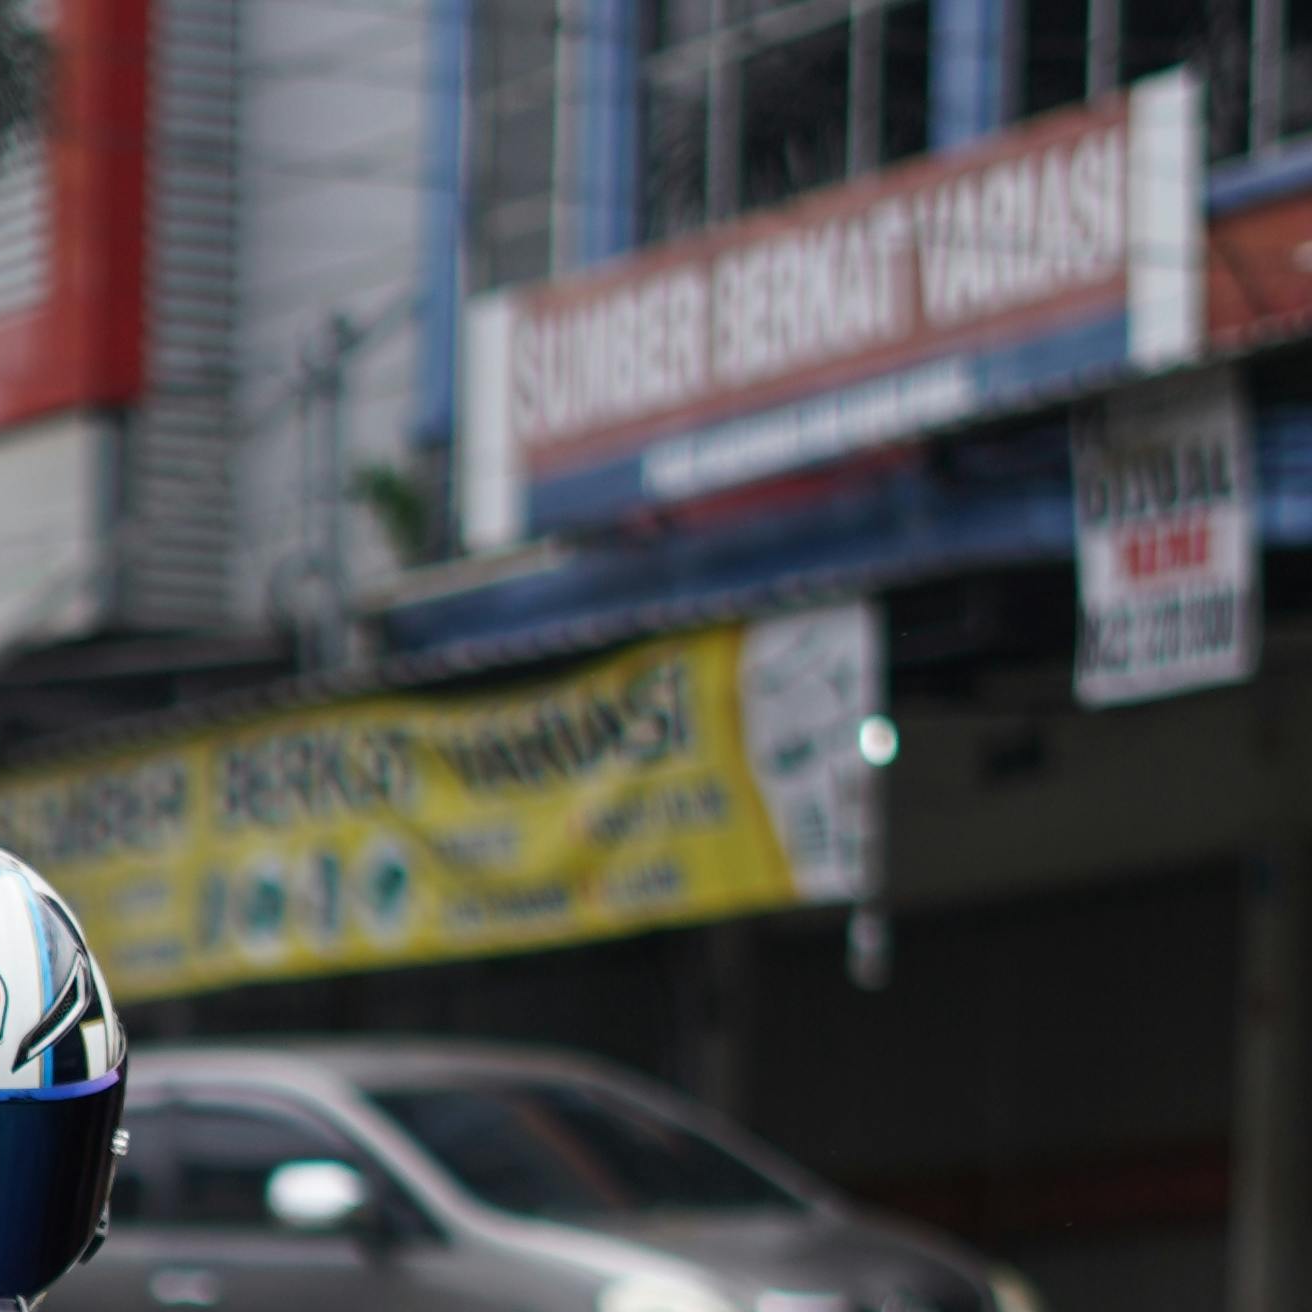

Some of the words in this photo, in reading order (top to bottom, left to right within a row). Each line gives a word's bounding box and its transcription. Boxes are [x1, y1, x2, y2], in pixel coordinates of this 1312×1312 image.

[512, 266, 707, 445] SUMBER
[713, 197, 912, 386] BERKAT
[915, 125, 1126, 326] VARIASI
